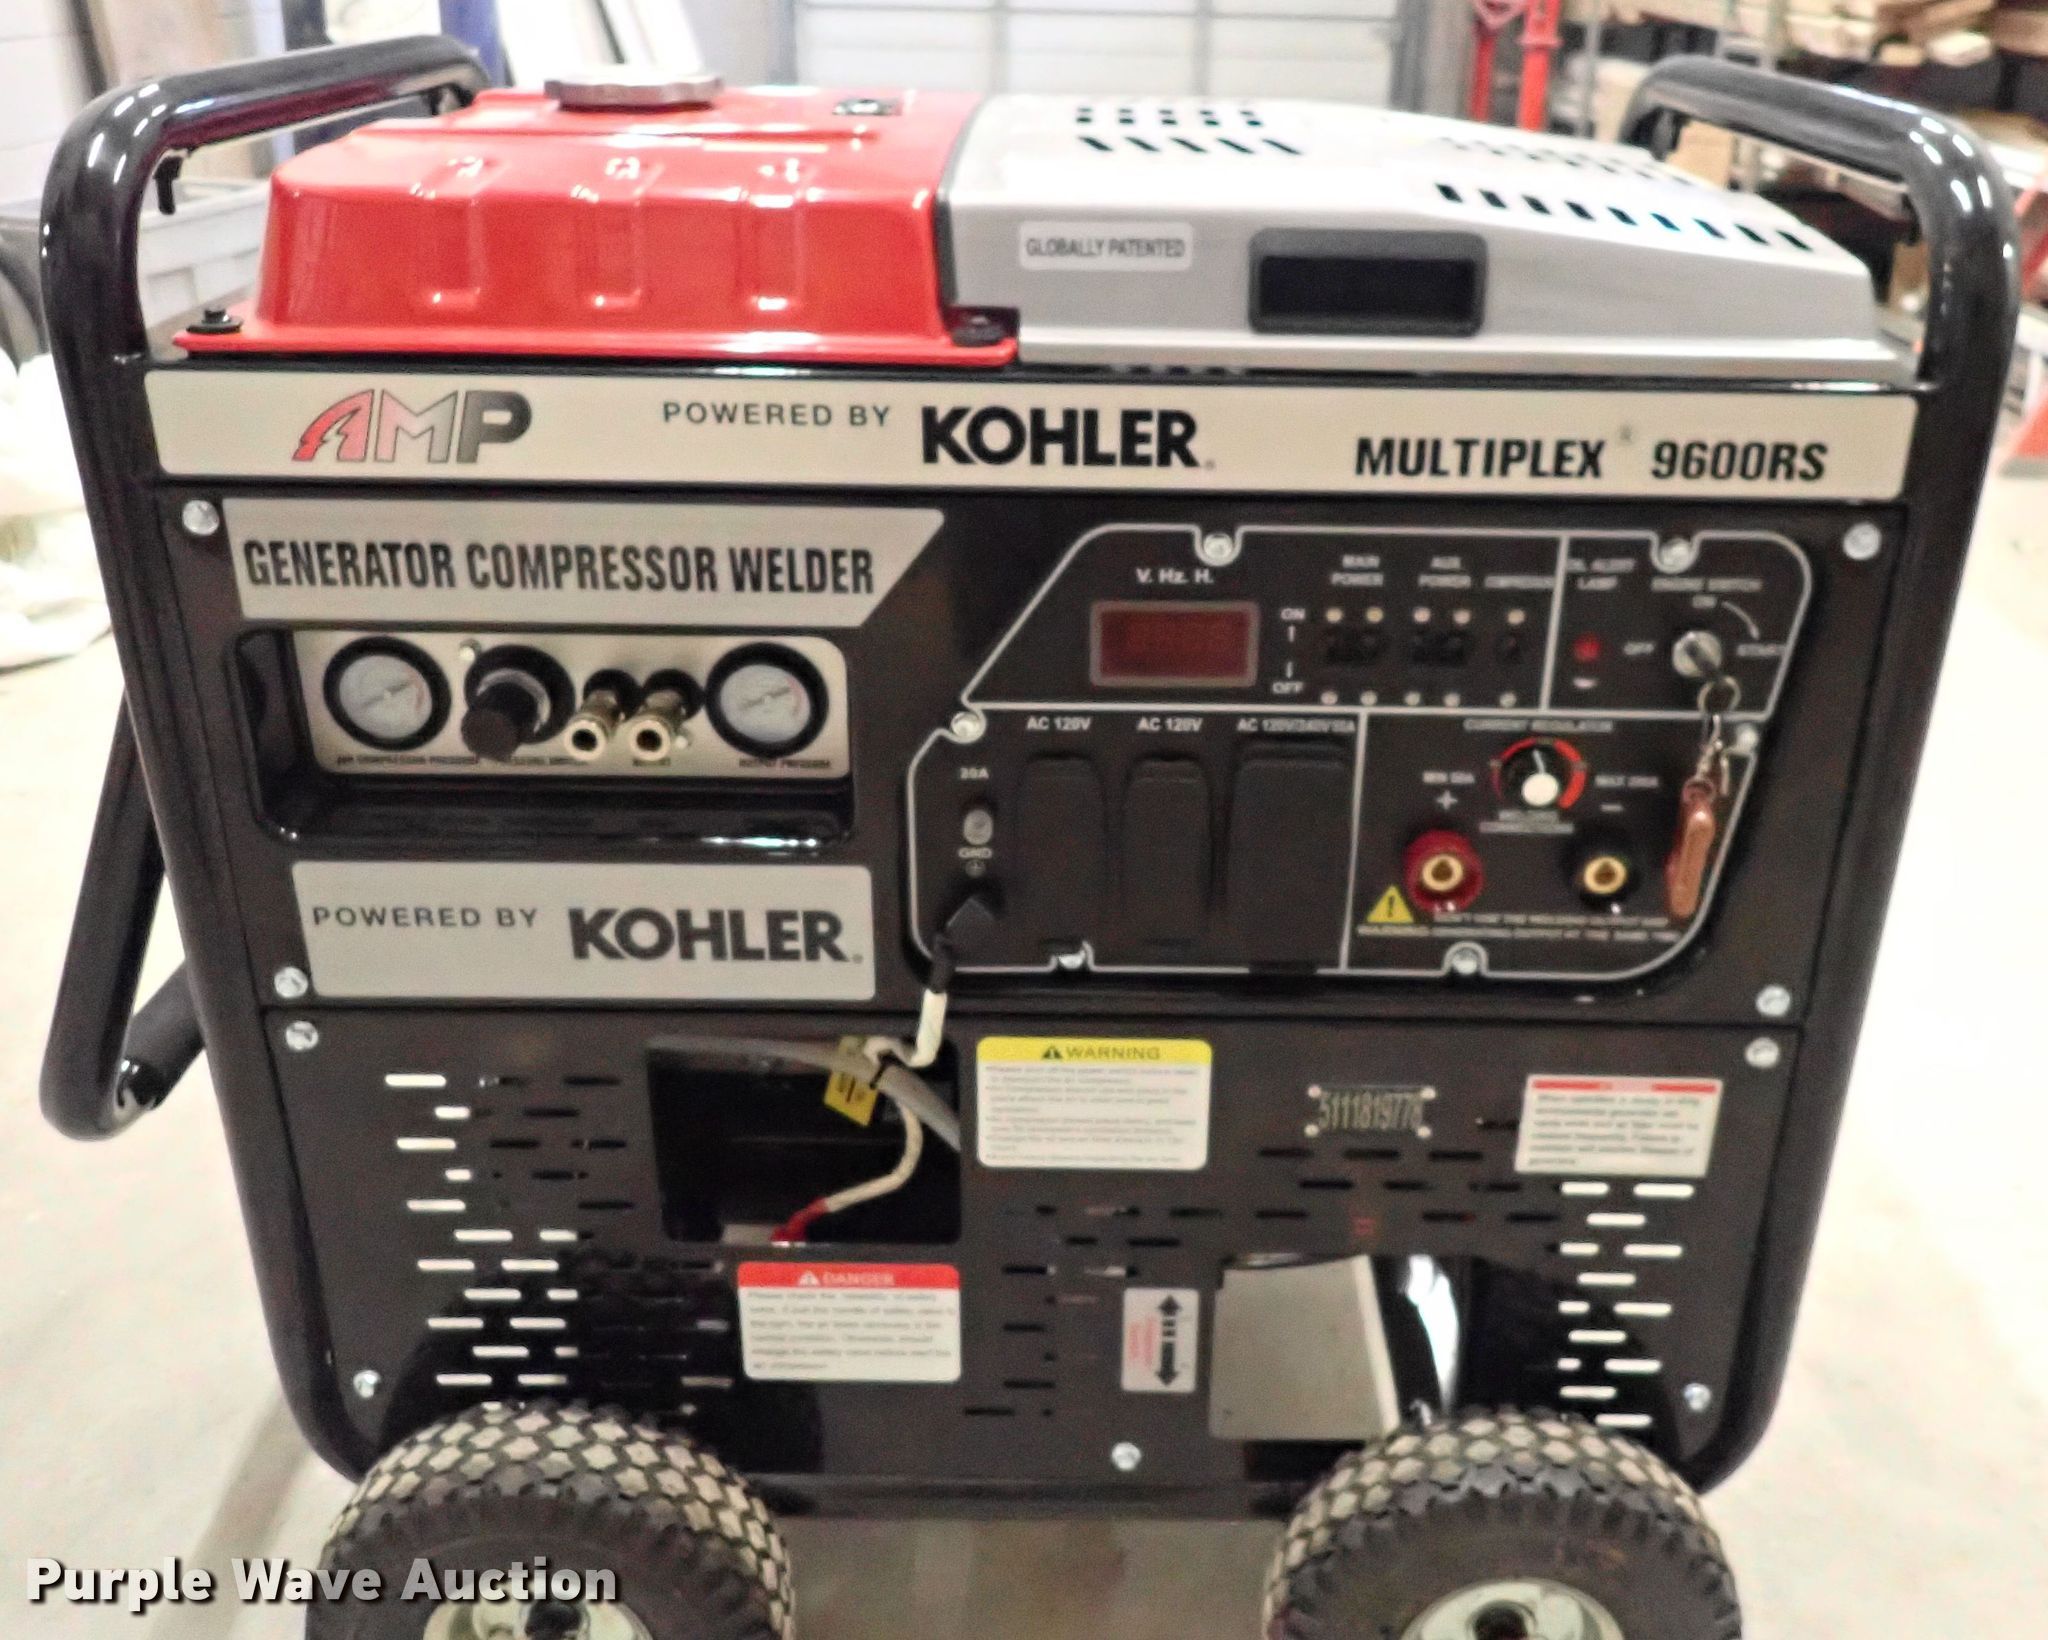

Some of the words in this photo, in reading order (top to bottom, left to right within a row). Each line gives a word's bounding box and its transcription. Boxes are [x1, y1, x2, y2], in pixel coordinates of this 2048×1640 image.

[1026, 238, 1104, 258] GLOBALLY
[1108, 238, 1186, 258] PATENTED
[292, 388, 533, 465] AMP
[662, 402, 832, 427] POWERED
[848, 405, 890, 427] BY
[921, 406, 1200, 468] KOHLER
[1354, 437, 1606, 480] MULTIPLEX
[1651, 440, 1828, 482] 9600RS
[243, 539, 457, 589] GENERATOR
[466, 543, 719, 593] COMPRESSOR
[729, 546, 875, 595] WELDER
[1026, 716, 1049, 731] AC
[1136, 716, 1161, 732] AC
[1236, 718, 1258, 733] AC
[312, 906, 481, 928] POWERED
[496, 907, 538, 929] BY
[568, 907, 849, 963] KOHLER
[1065, 1046, 1161, 1061] WARNING
